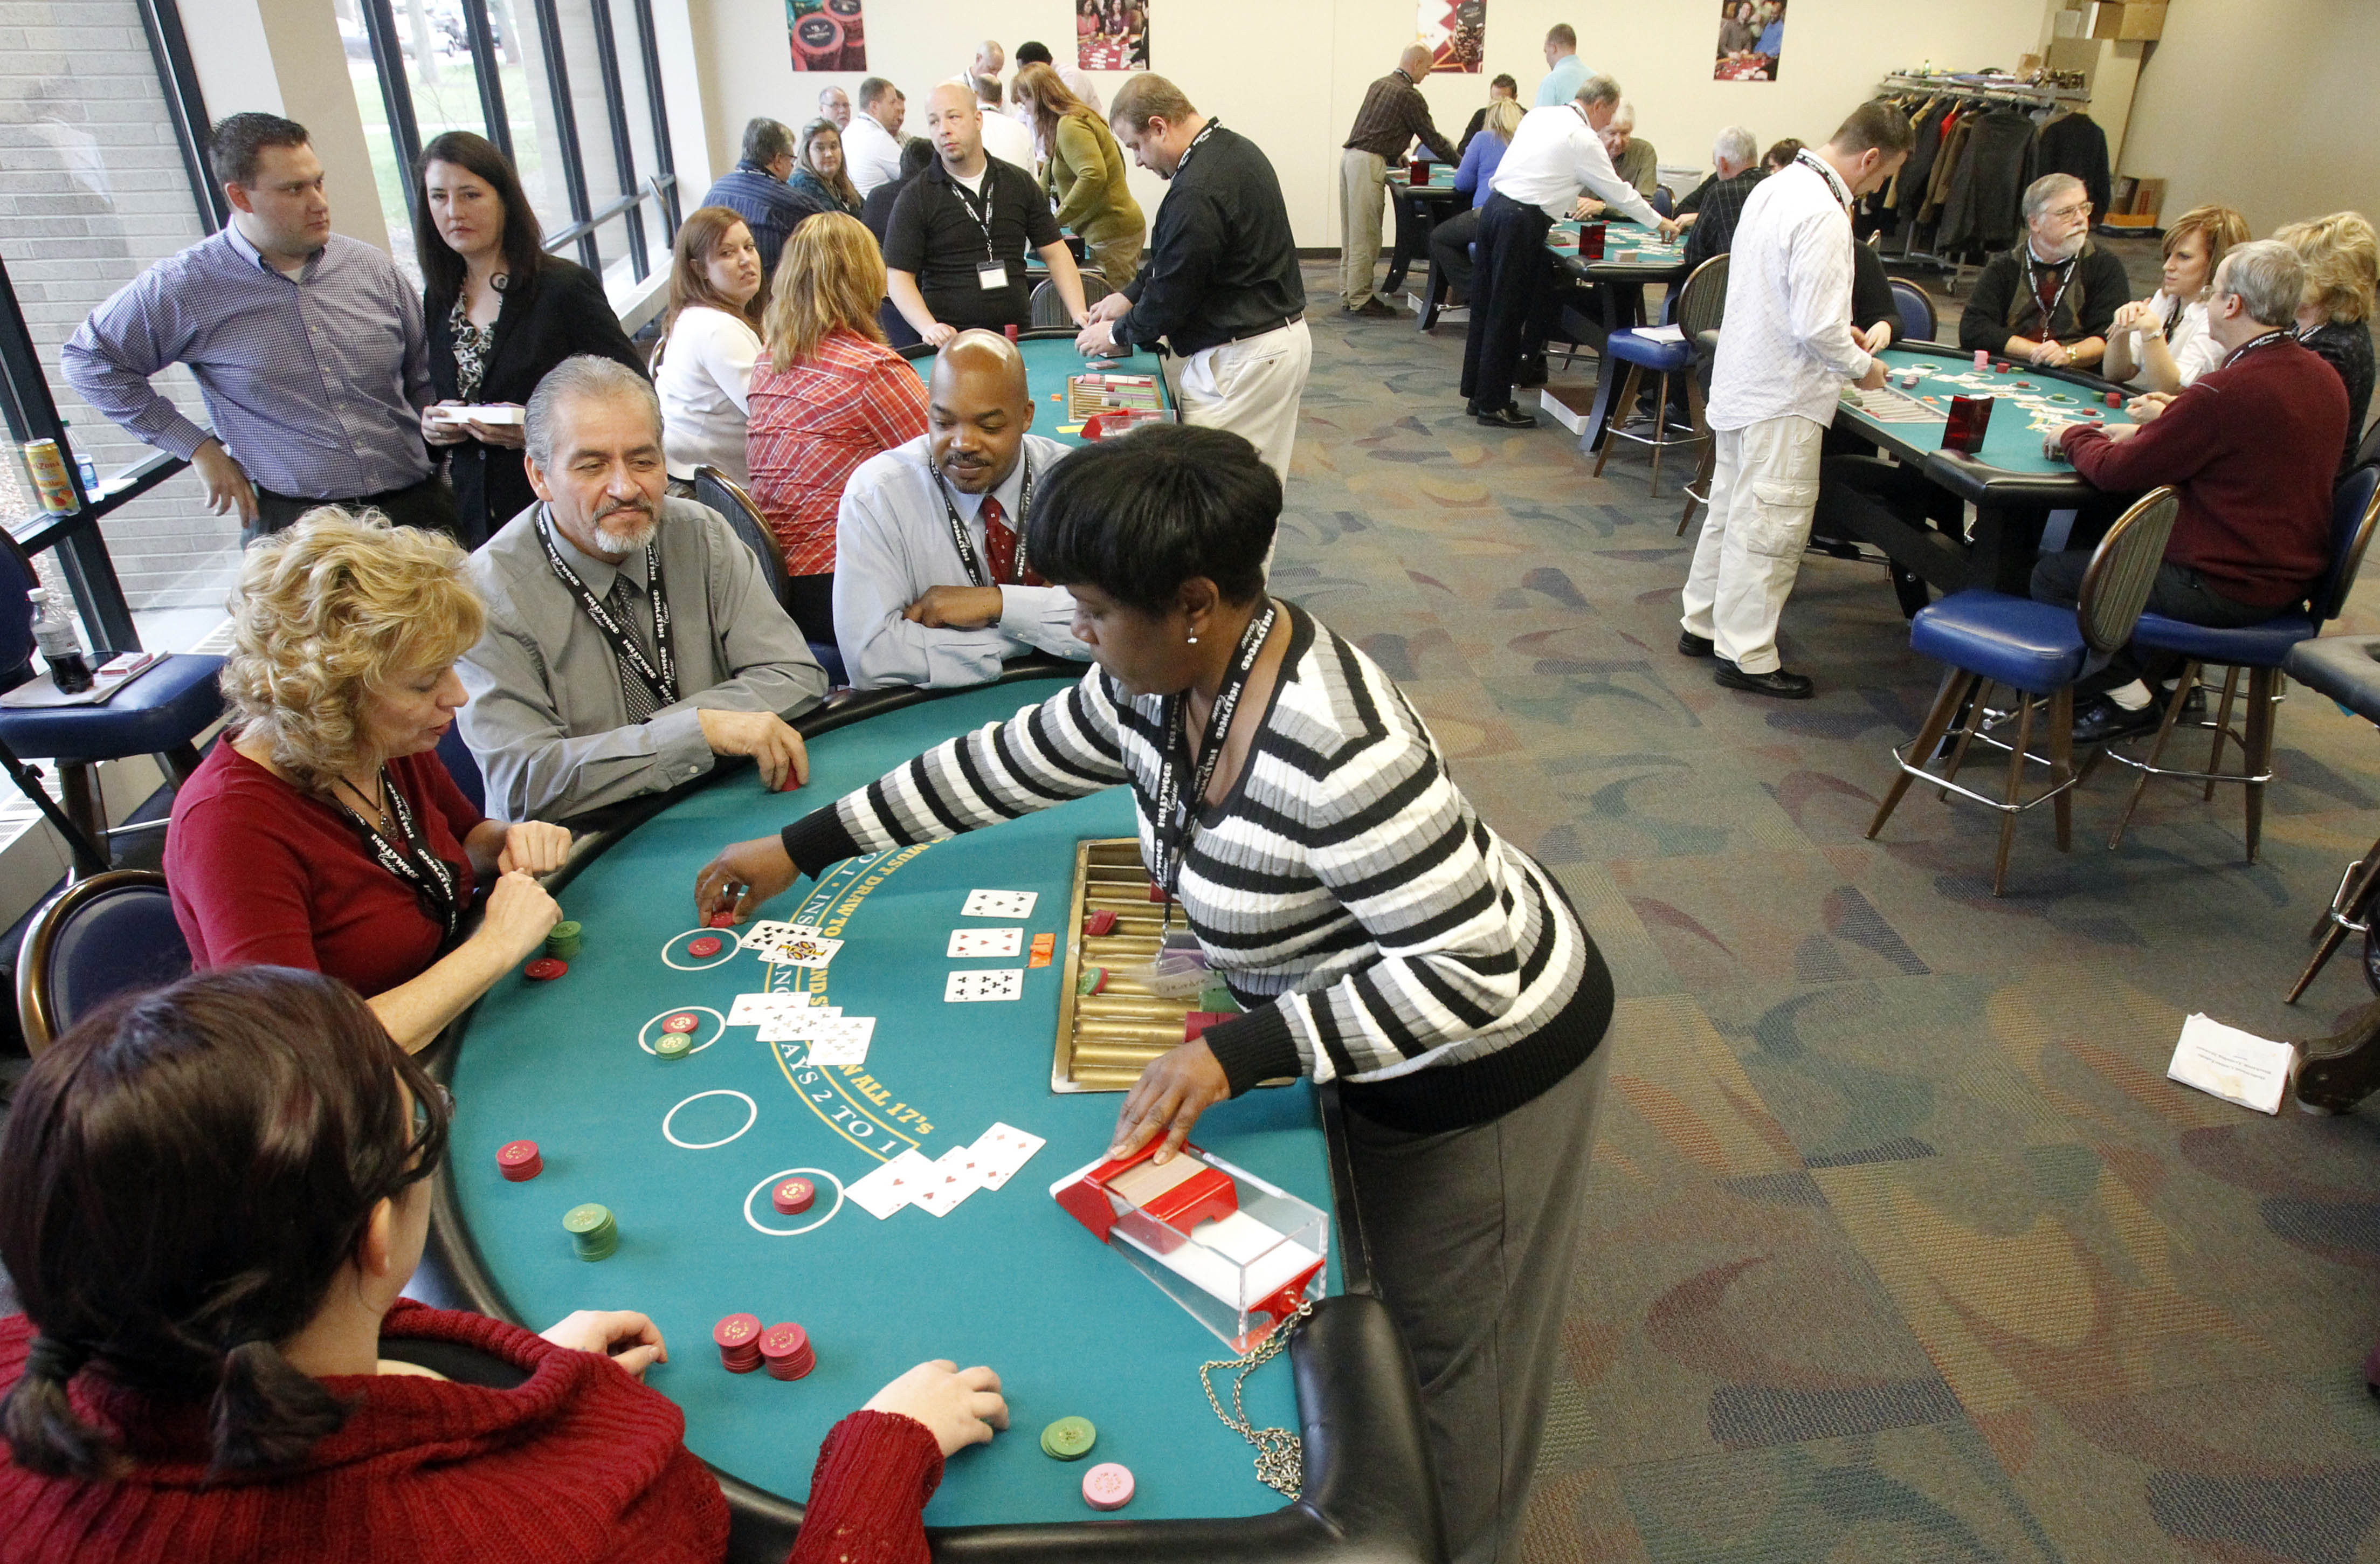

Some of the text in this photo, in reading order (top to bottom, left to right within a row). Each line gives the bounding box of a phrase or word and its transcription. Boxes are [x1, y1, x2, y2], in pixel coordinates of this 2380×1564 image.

[583, 592, 619, 633] HOLLYWOOD
[653, 589, 665, 638] HOLLYWOOD
[1241, 619, 1261, 649] Casino
[623, 639, 657, 679] HOLLYWOOD
[1241, 608, 1274, 670] HOLLYWOOD
[1212, 694, 1229, 722] Casino
[1215, 681, 1241, 740] HOLLYWOOD
[387, 781, 415, 839] HOLLYWOOD
[1157, 762, 1172, 828] HOLLYWOOD
[1168, 781, 1179, 811] Casino
[371, 833, 419, 879] HOLLYWOOD
[378, 851, 400, 874] Casino
[418, 849, 453, 900] HOLLYWOOD
[824, 843, 931, 937] MUST DRAW TO
[781, 1044, 898, 1153] AYS 2 TO 1
[850, 1074, 892, 1107] ALL
[886, 1103, 935, 1134] 17's
